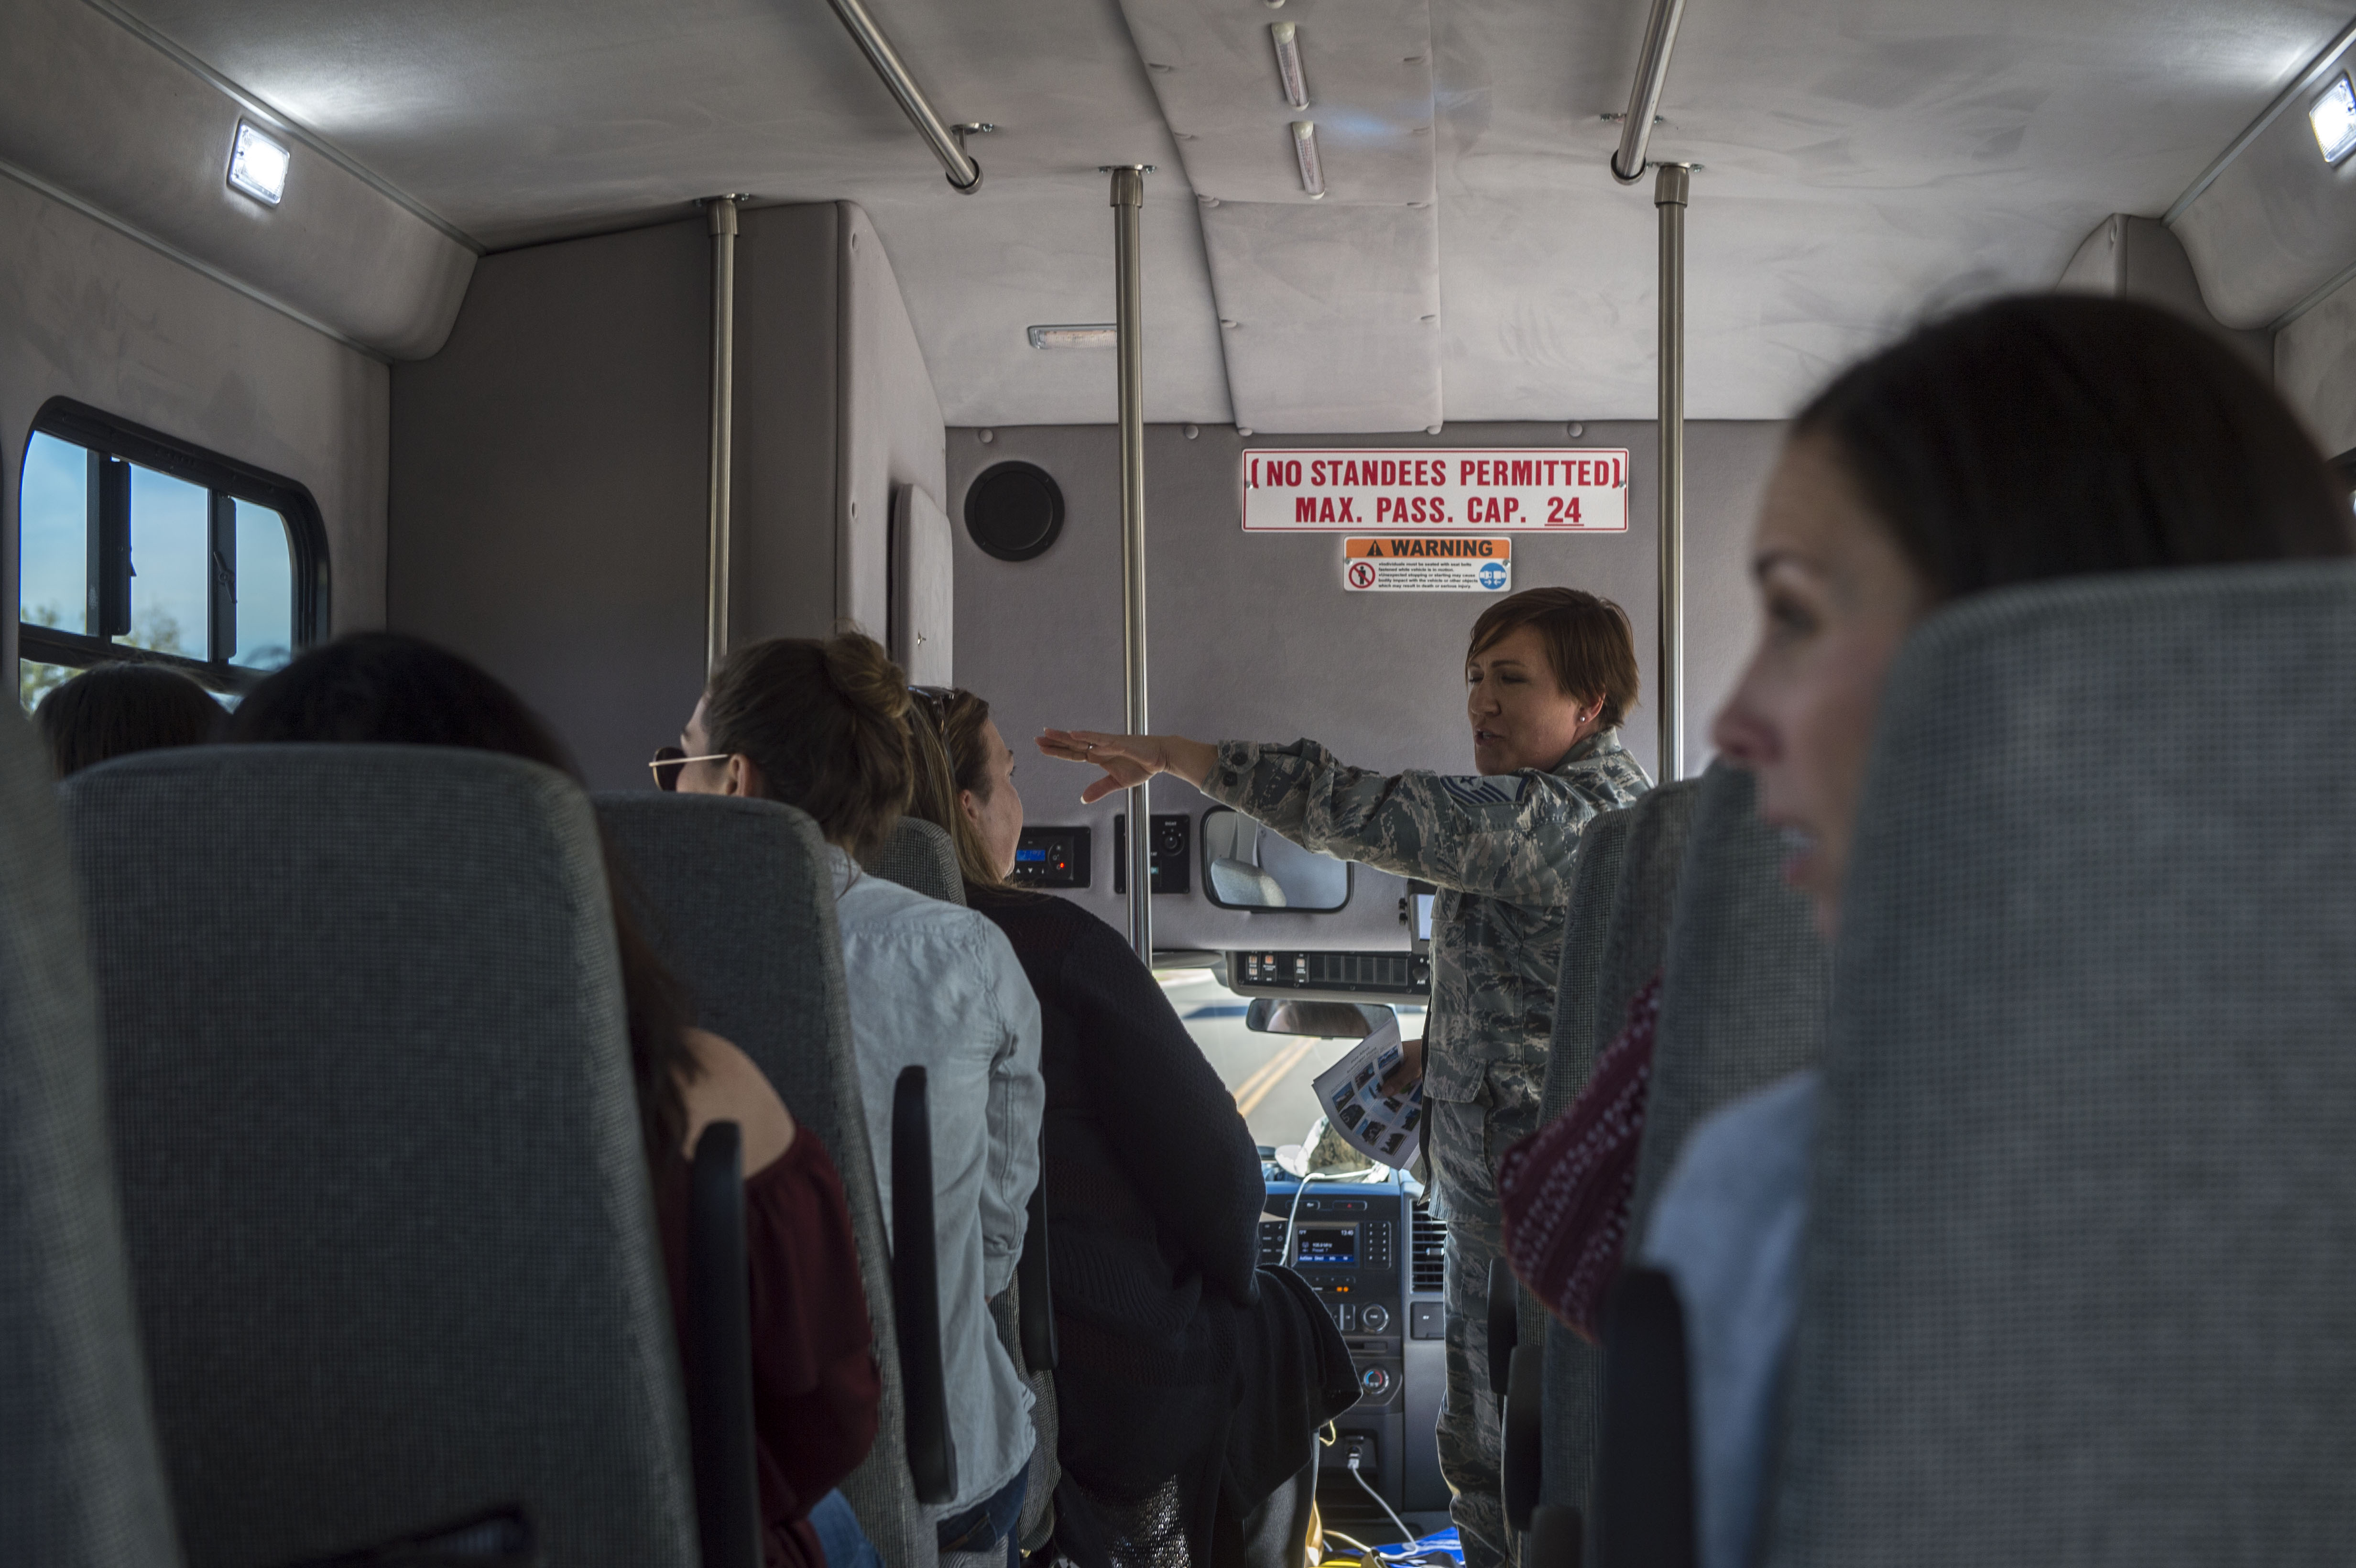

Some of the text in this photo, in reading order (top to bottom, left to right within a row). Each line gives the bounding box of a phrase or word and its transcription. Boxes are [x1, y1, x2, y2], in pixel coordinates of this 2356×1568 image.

[1311, 459, 1446, 487] STANDEES
[1460, 457, 1620, 489] PERMITTED)
[1296, 496, 1584, 526] MAX. PASS. CAP. 24
[1391, 539, 1493, 556] WARNING
